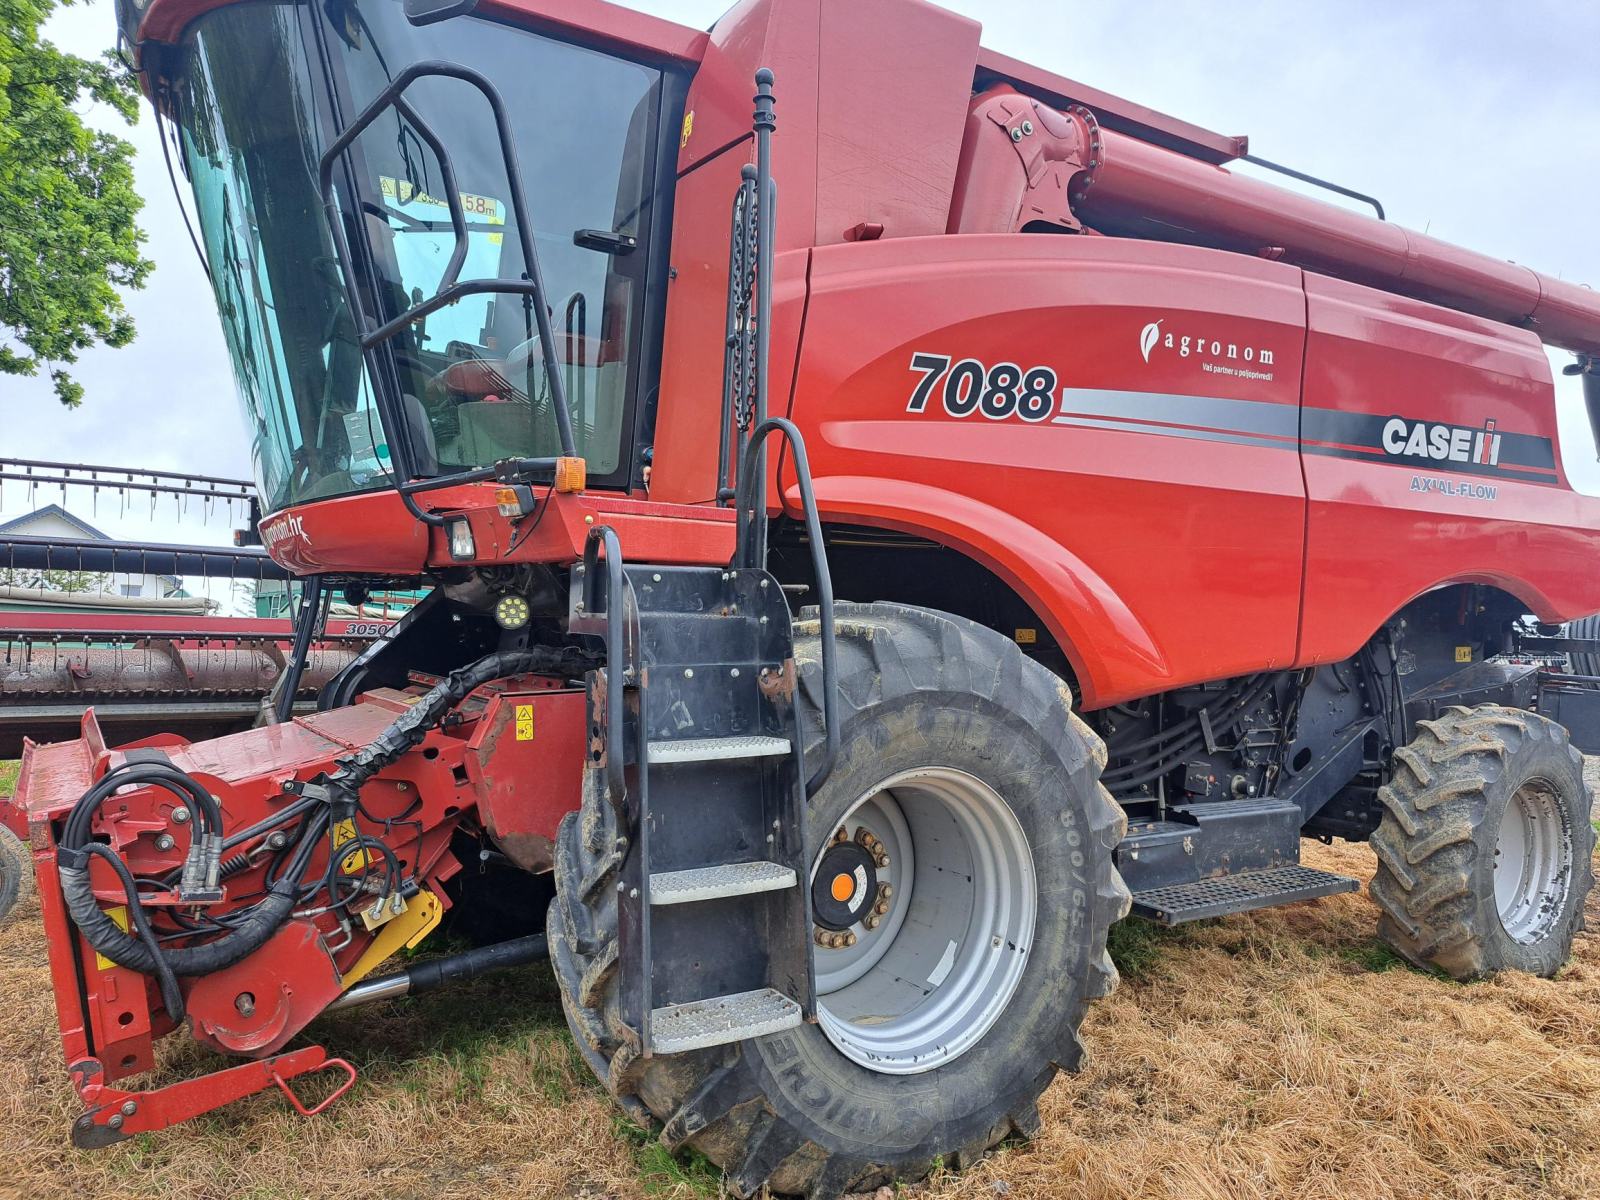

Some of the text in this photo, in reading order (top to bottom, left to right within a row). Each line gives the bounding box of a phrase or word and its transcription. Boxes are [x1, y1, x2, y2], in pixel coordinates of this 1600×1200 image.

[1165, 333, 1273, 364] agronom
[906, 351, 1057, 423] 7088
[1213, 366, 1234, 376] partner
[1382, 418, 1472, 463] CASE
[345, 622, 388, 636] 3050
[1060, 808, 1087, 930] 800/65
